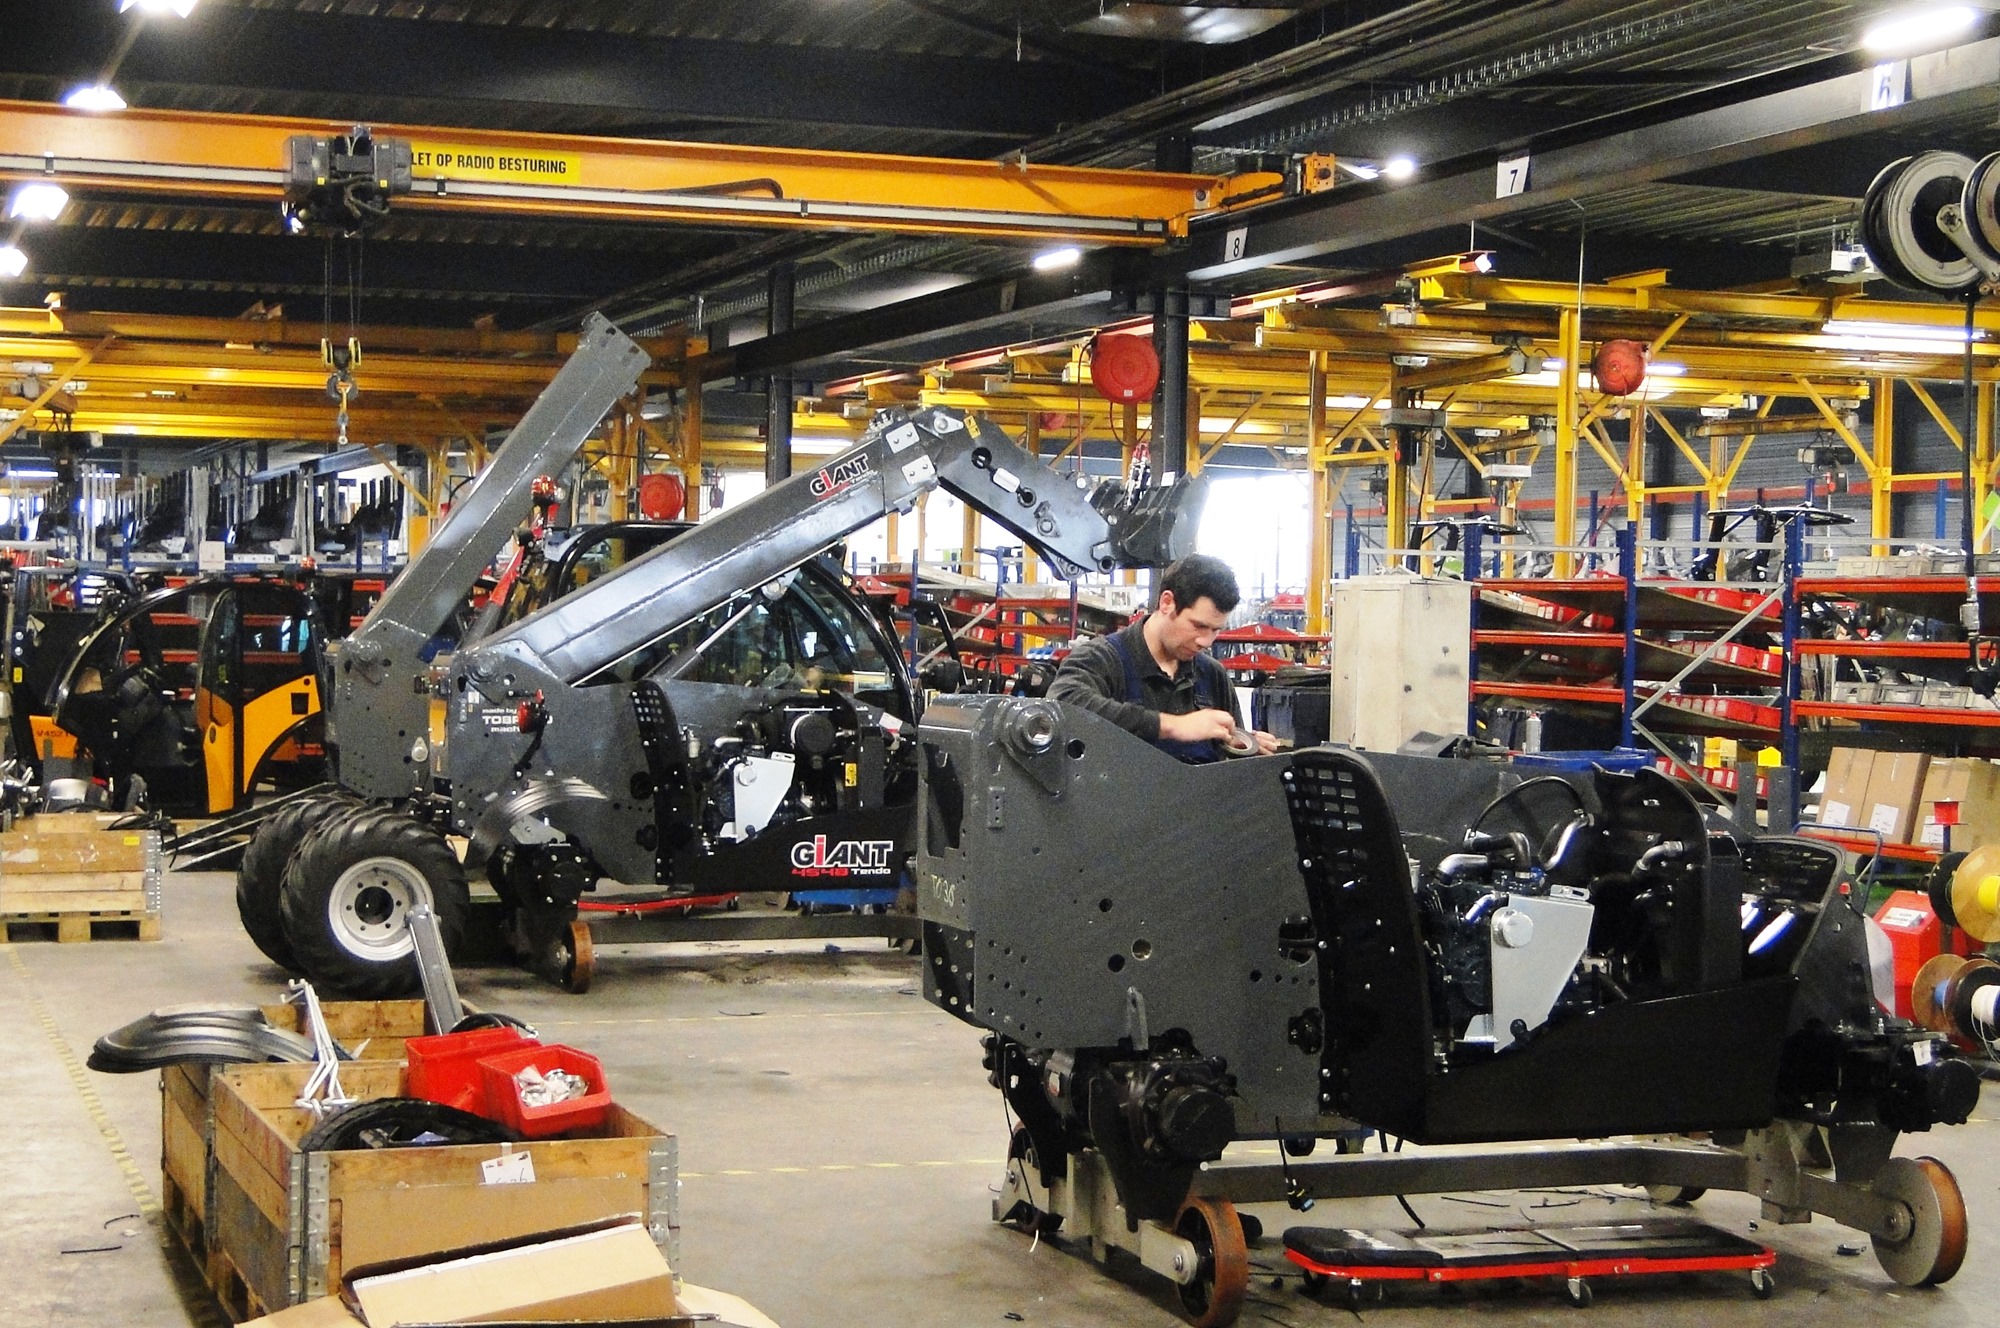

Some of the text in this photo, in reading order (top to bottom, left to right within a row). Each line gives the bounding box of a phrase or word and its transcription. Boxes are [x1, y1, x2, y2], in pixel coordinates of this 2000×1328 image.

[412, 152, 566, 174] LET OP RADIO BESTURING
[1510, 169, 1519, 194] 7
[1233, 237, 1240, 258] 8
[851, 867, 891, 875] Tendo
